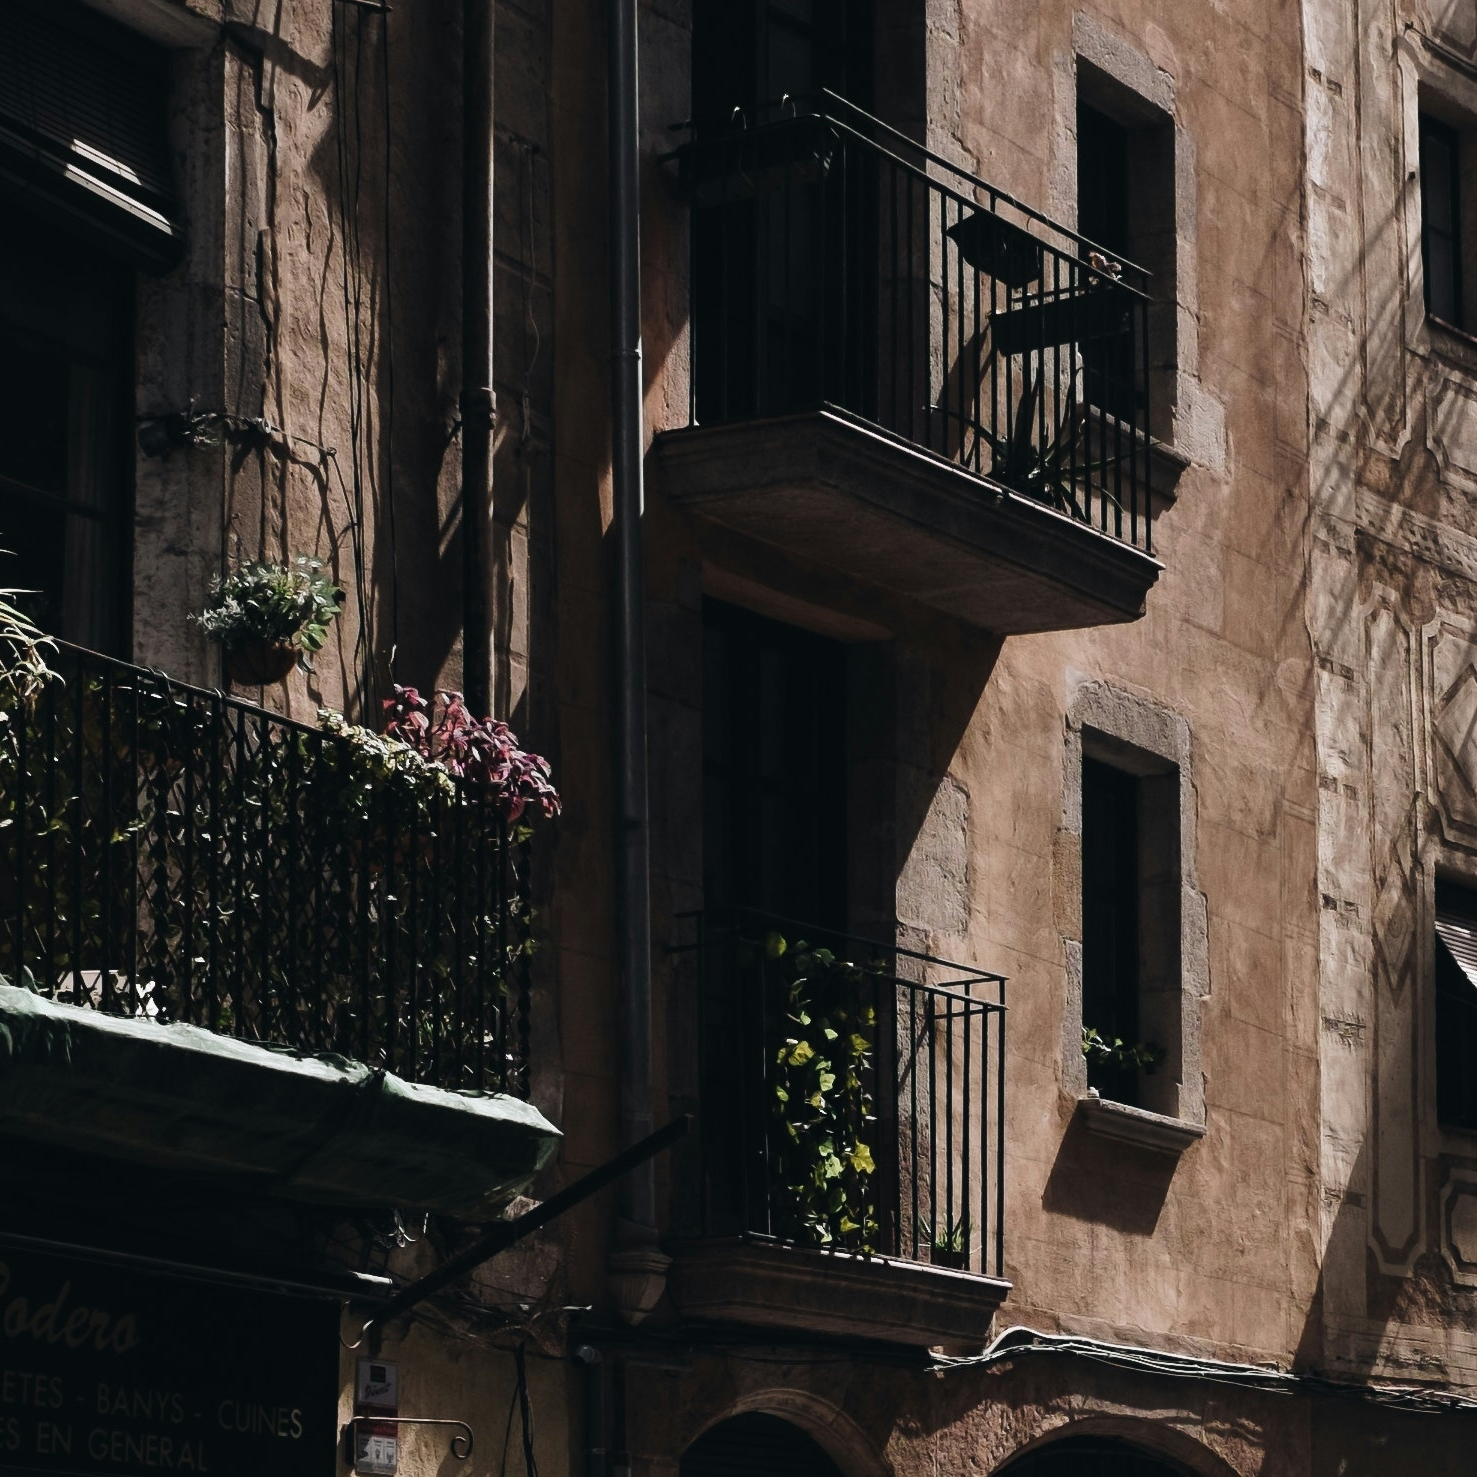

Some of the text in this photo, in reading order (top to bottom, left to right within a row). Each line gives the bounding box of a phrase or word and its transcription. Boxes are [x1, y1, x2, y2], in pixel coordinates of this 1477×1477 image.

[96, 1382, 185, 1425] BANYS
[218, 1399, 303, 1440] CUINES
[36, 1422, 72, 1455] EN
[87, 1428, 209, 1473] GENERAL
